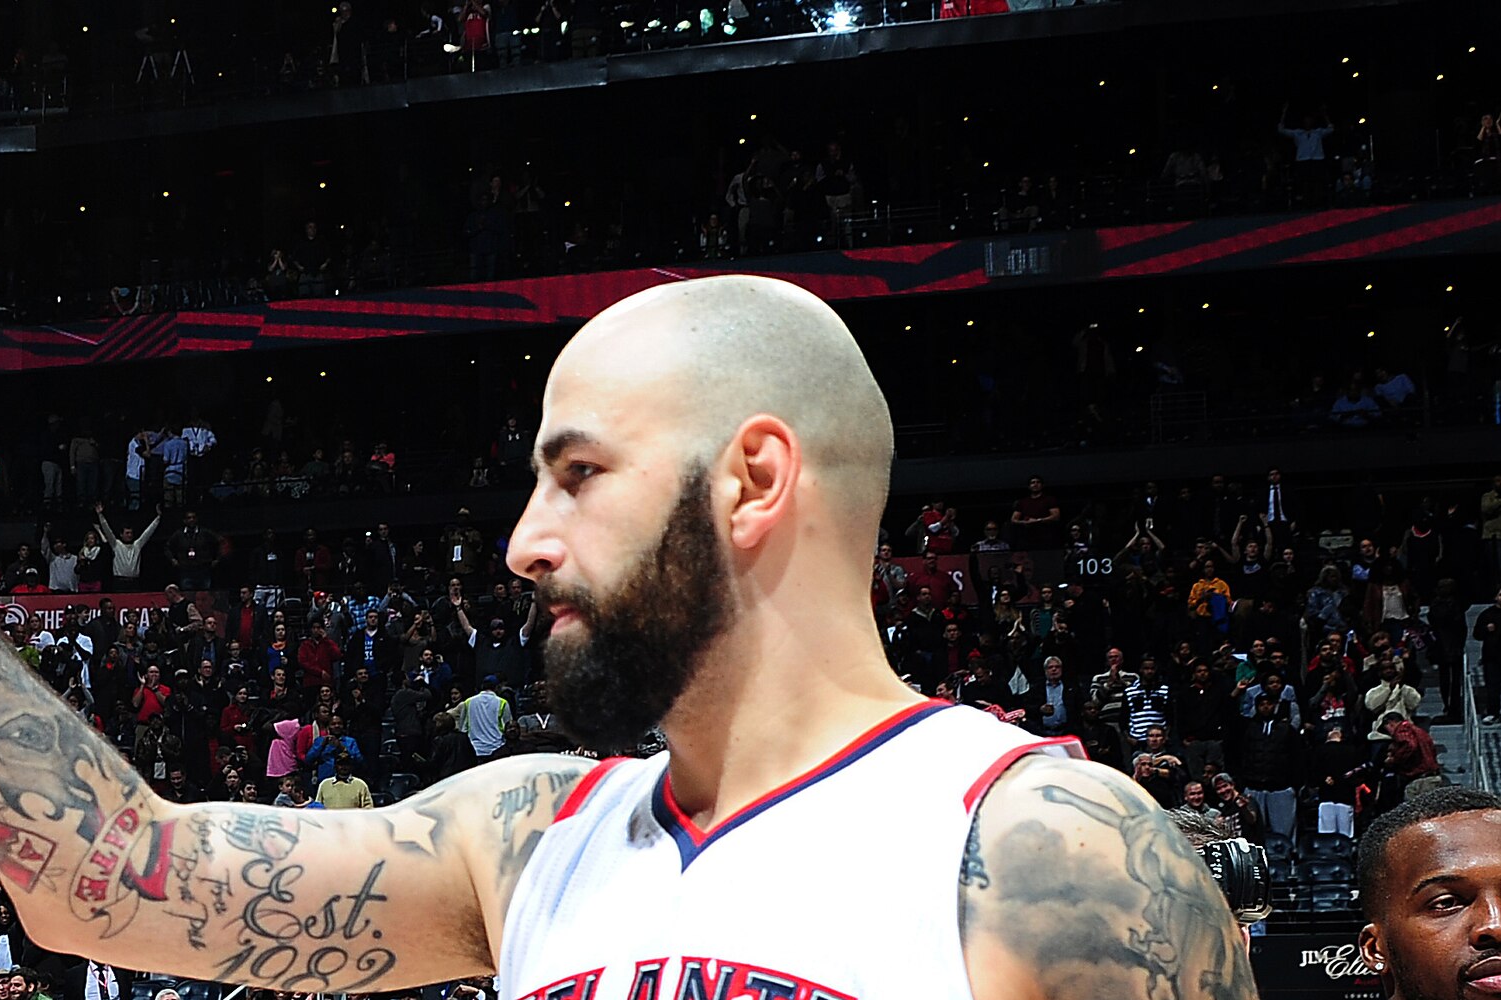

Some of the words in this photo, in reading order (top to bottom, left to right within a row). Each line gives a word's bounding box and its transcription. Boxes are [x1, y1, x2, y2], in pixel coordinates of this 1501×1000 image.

[1077, 558, 1103, 575] 103
[35, 610, 65, 630] THE
[240, 858, 388, 943] Est.
